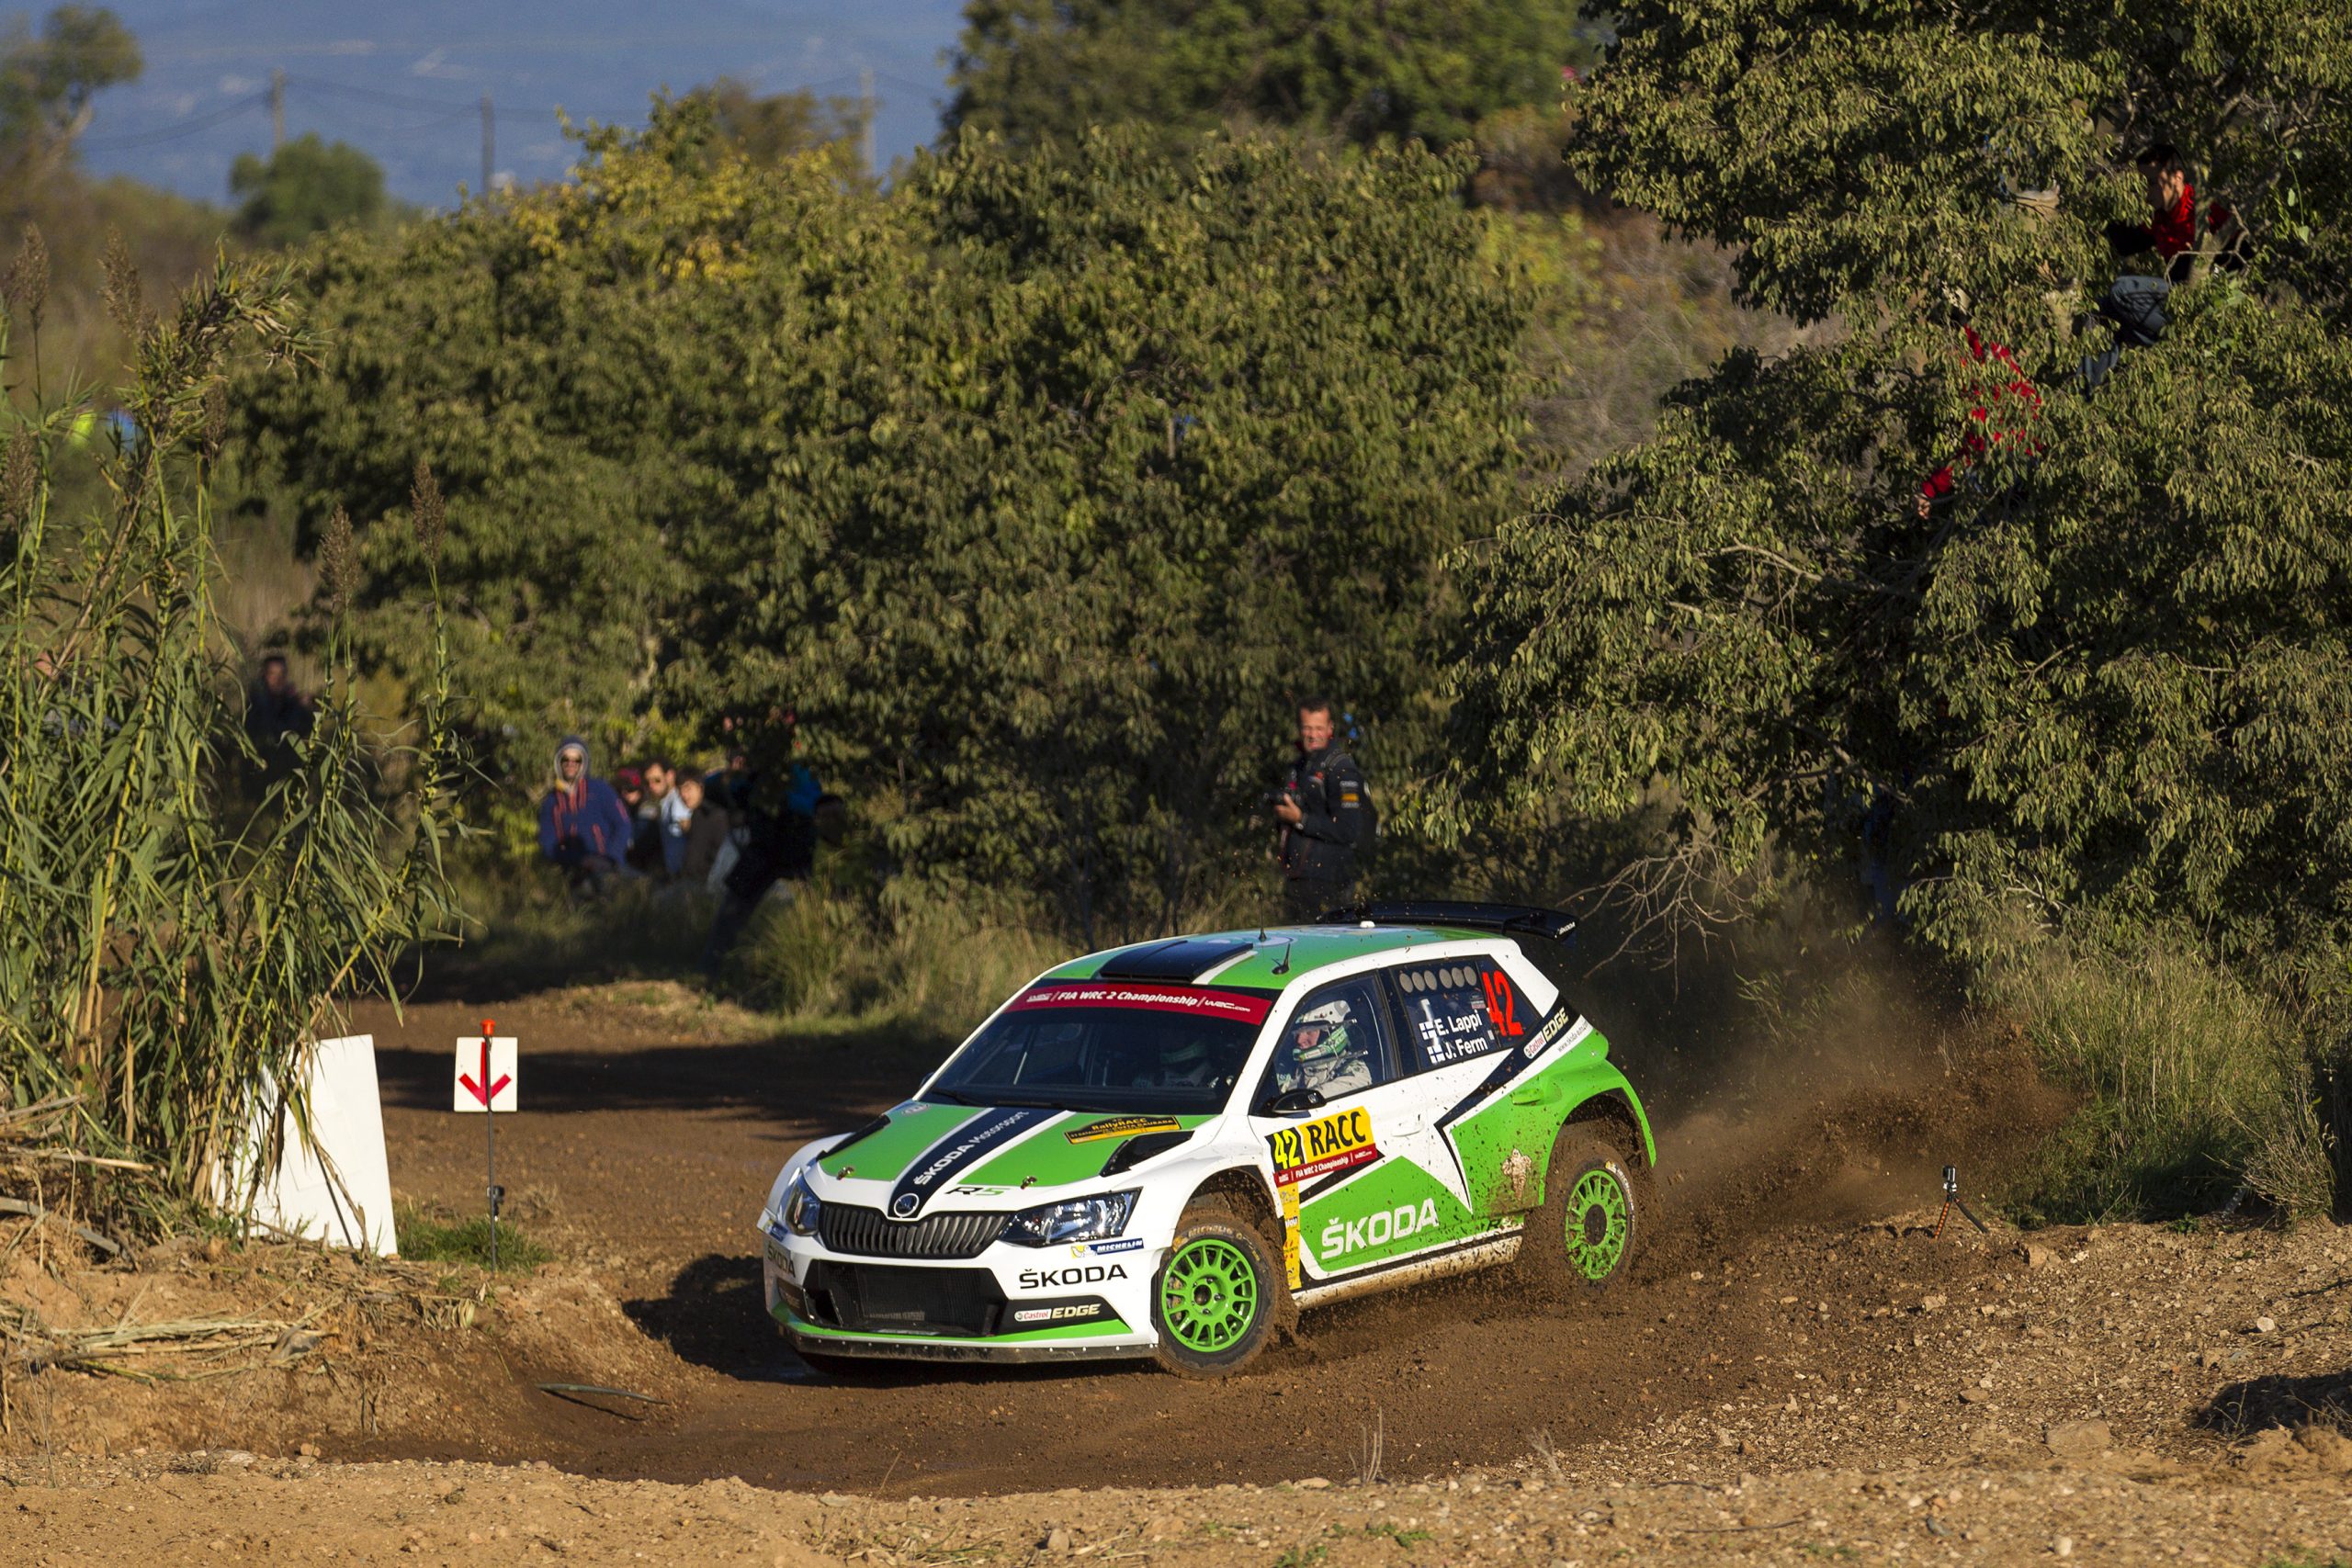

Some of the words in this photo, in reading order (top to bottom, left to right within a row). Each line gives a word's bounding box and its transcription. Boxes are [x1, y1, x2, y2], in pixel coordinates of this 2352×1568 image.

[1057, 991, 1077, 1000] FIA
[1079, 991, 1106, 1000] WRC
[1106, 991, 1116, 1000] 2
[1117, 991, 1198, 1007] Championship
[1482, 969, 1524, 1037] 42
[1434, 1019, 1450, 1037] E.
[1447, 1009, 1483, 1034] Lappi
[1543, 1007, 1569, 1043] EDGE
[1444, 1046, 1457, 1061] J.
[1455, 1037, 1488, 1057] Ferm
[1273, 1129, 1301, 1170] 42
[1306, 1111, 1367, 1157] RACC
[912, 1144, 975, 1185] ŠKODA
[1318, 1156, 1349, 1171] Championship
[1320, 1197, 1440, 1259] ŠKODA
[1096, 1240, 1144, 1253] MICHELIN
[1019, 1264, 1128, 1290] ŠKODA
[1023, 1310, 1049, 1320] Castrol
[1051, 1303, 1102, 1319] EDGE
